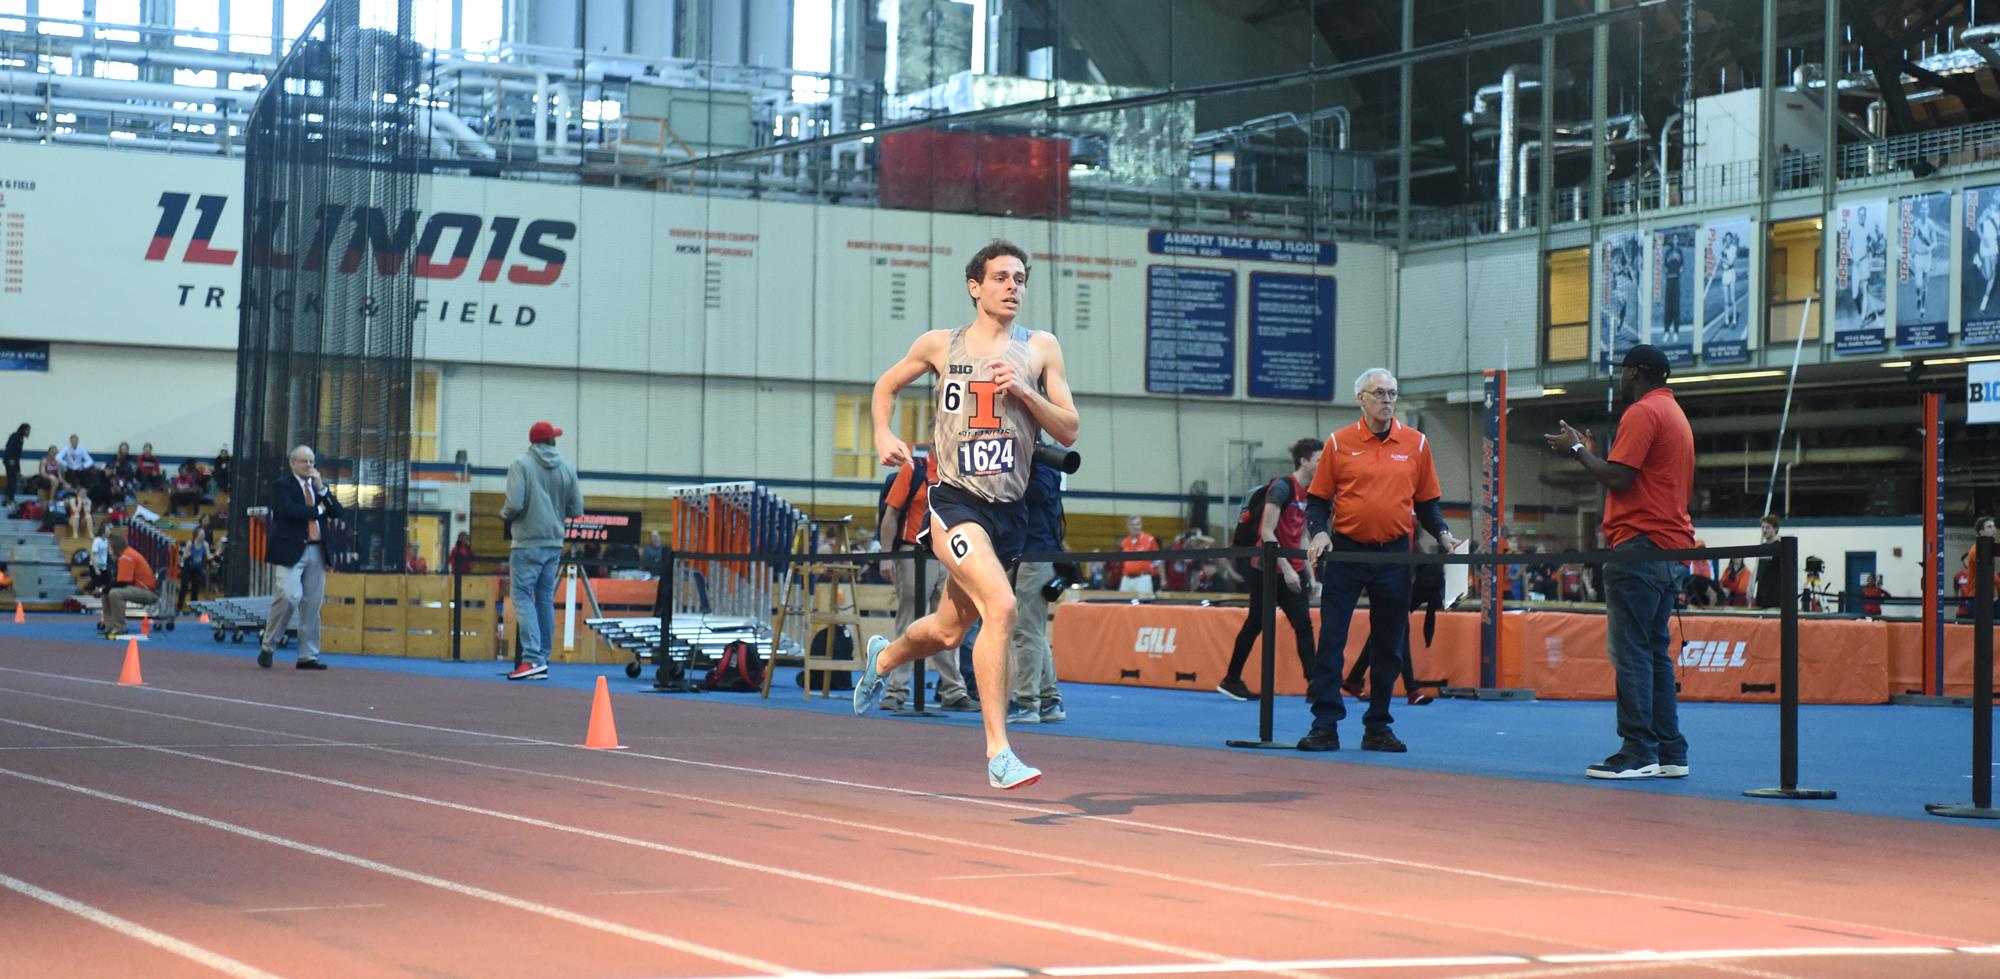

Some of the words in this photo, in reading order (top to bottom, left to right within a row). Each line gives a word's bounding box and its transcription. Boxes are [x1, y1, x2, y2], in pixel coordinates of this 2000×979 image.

[13, 181, 36, 191] FIELD
[144, 191, 577, 287] ILLINOIS
[1164, 232, 1214, 247] ARMORY
[1217, 235, 1253, 250] TRACK
[1256, 238, 1282, 251] AND
[1284, 239, 1322, 254] FLOOR
[177, 284, 325, 315] TRACK
[413, 299, 537, 328] FIELD
[945, 382, 960, 411] 6
[960, 439, 1014, 473] 1624
[951, 533, 968, 559] 6
[1135, 626, 1177, 654] GILL
[1677, 640, 1748, 667] GILL
